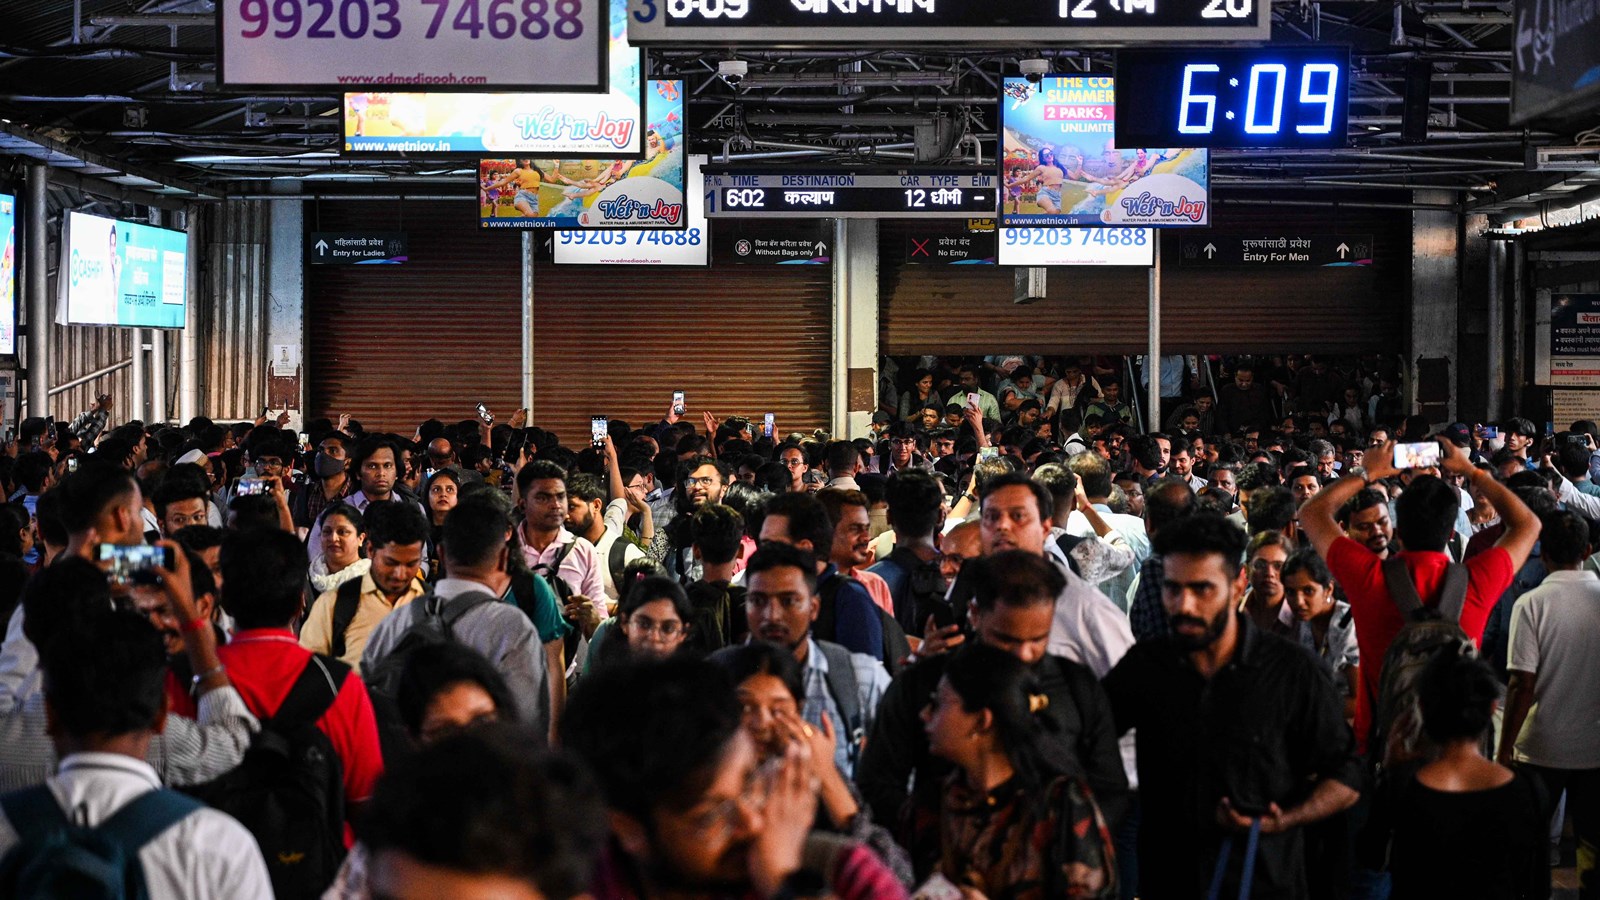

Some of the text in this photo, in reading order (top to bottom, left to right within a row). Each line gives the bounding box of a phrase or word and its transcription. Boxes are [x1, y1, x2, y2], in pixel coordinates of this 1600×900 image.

[240, 0, 584, 39] 99203 74688
[337, 73, 487, 84] www.admediaooh.com
[1056, 78, 1083, 88] THE
[1047, 89, 1115, 103] SUMMER
[1178, 63, 1339, 134] 6:09
[1046, 107, 1108, 120] 2 PARKS,
[731, 175, 759, 187] TIME
[782, 175, 855, 187] DESTINATION
[900, 175, 920, 187] CAR
[930, 175, 959, 187] TYPE
[971, 175, 991, 187] EIM
[705, 190, 716, 213] 1
[726, 188, 765, 207] 6:02
[783, 191, 835, 205] कल्याण
[904, 189, 926, 207] 12
[650, 198, 682, 226] Joy
[1173, 196, 1206, 223] Joy
[560, 229, 701, 246] 99203 74688
[1005, 228, 1147, 246] 99203 74688
[1289, 236, 1311, 248] प्रवेश
[782, 249, 798, 257] Bags
[800, 249, 814, 257] only
[950, 250, 968, 258] Entry
[1243, 253, 1309, 263] Entry For Men
